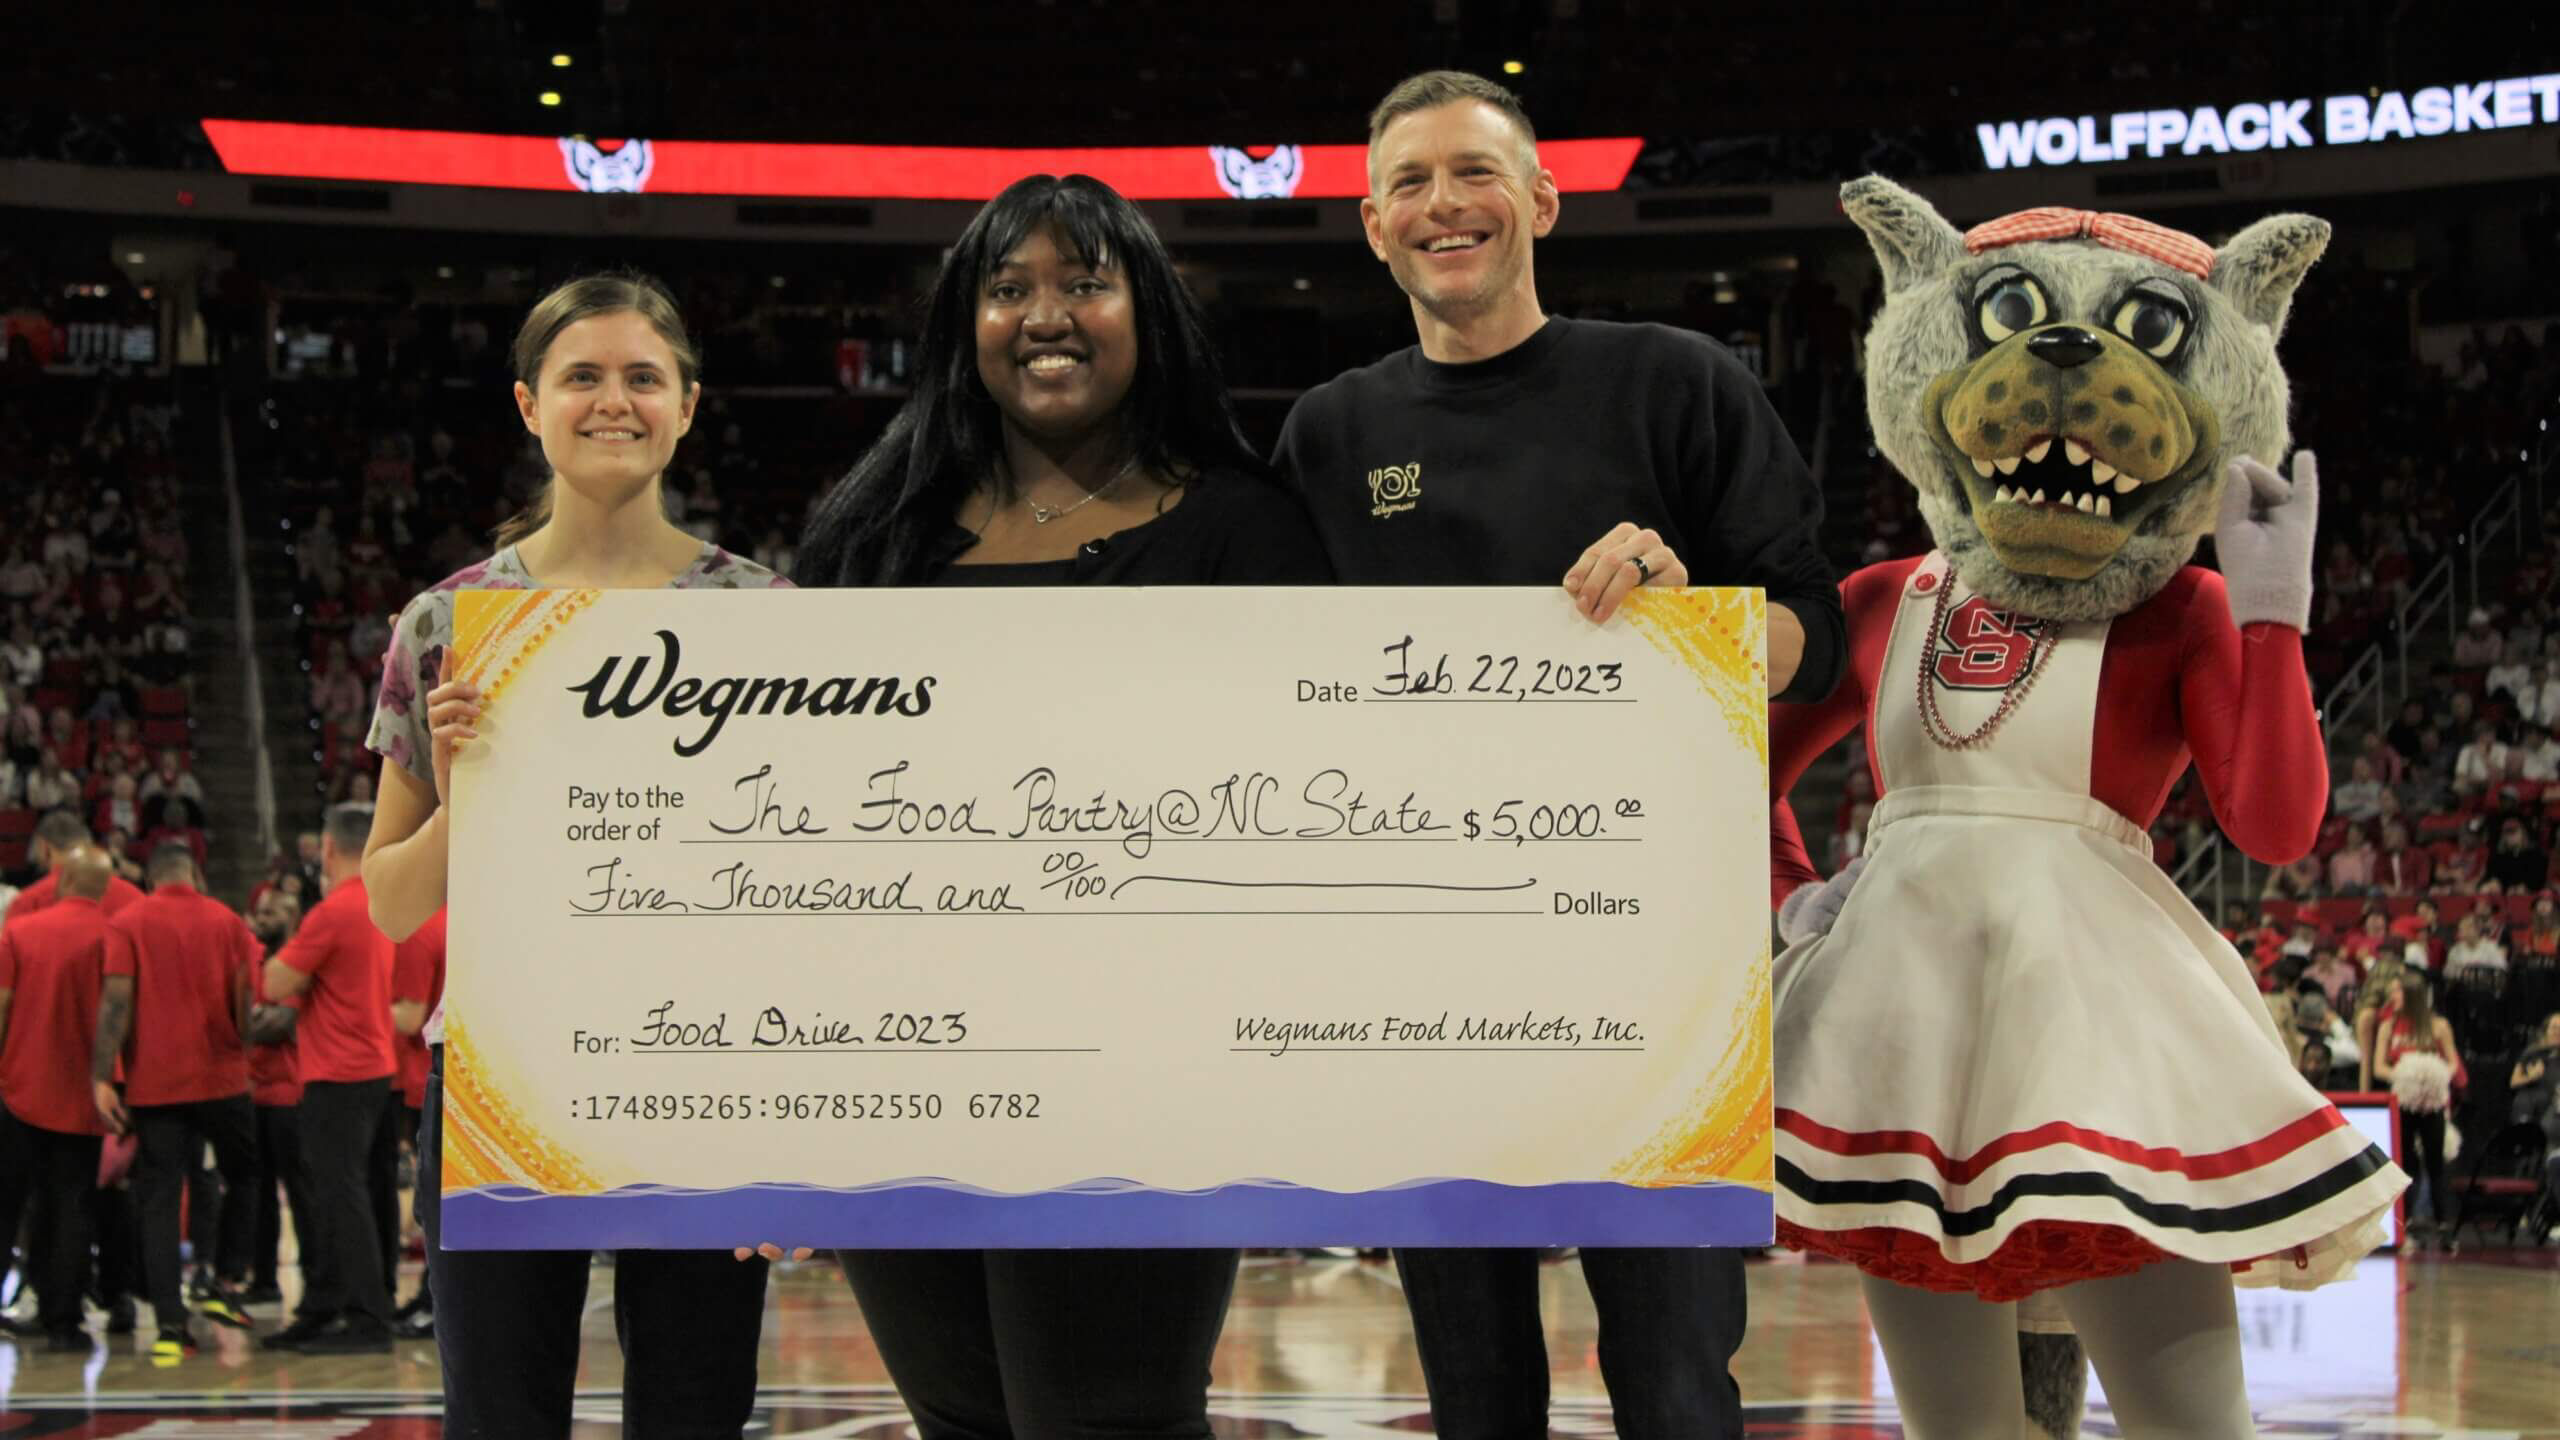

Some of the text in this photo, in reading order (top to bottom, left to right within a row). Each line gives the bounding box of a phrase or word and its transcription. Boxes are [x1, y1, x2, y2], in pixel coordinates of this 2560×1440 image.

[1978, 74, 2560, 168] WOLFPACK BASKET
[1372, 634, 1457, 696] Feb.
[566, 629, 938, 758] Wegmans
[1297, 679, 1358, 703] Date
[568, 784, 684, 814] Pay to the
[708, 763, 829, 836] The
[852, 759, 997, 836] Food
[1295, 768, 1451, 838] State
[566, 816, 661, 841] order of
[569, 856, 689, 913] Five
[693, 861, 924, 913] Thousand
[937, 883, 1025, 913] and
[1554, 891, 1640, 916] Dollars
[573, 1030, 620, 1054] For:
[630, 999, 967, 1048] Food Drive 2023
[1234, 1010, 1644, 1057] Wegmans Food Markets, Inc.
[969, 1093, 1040, 1119] 6782
